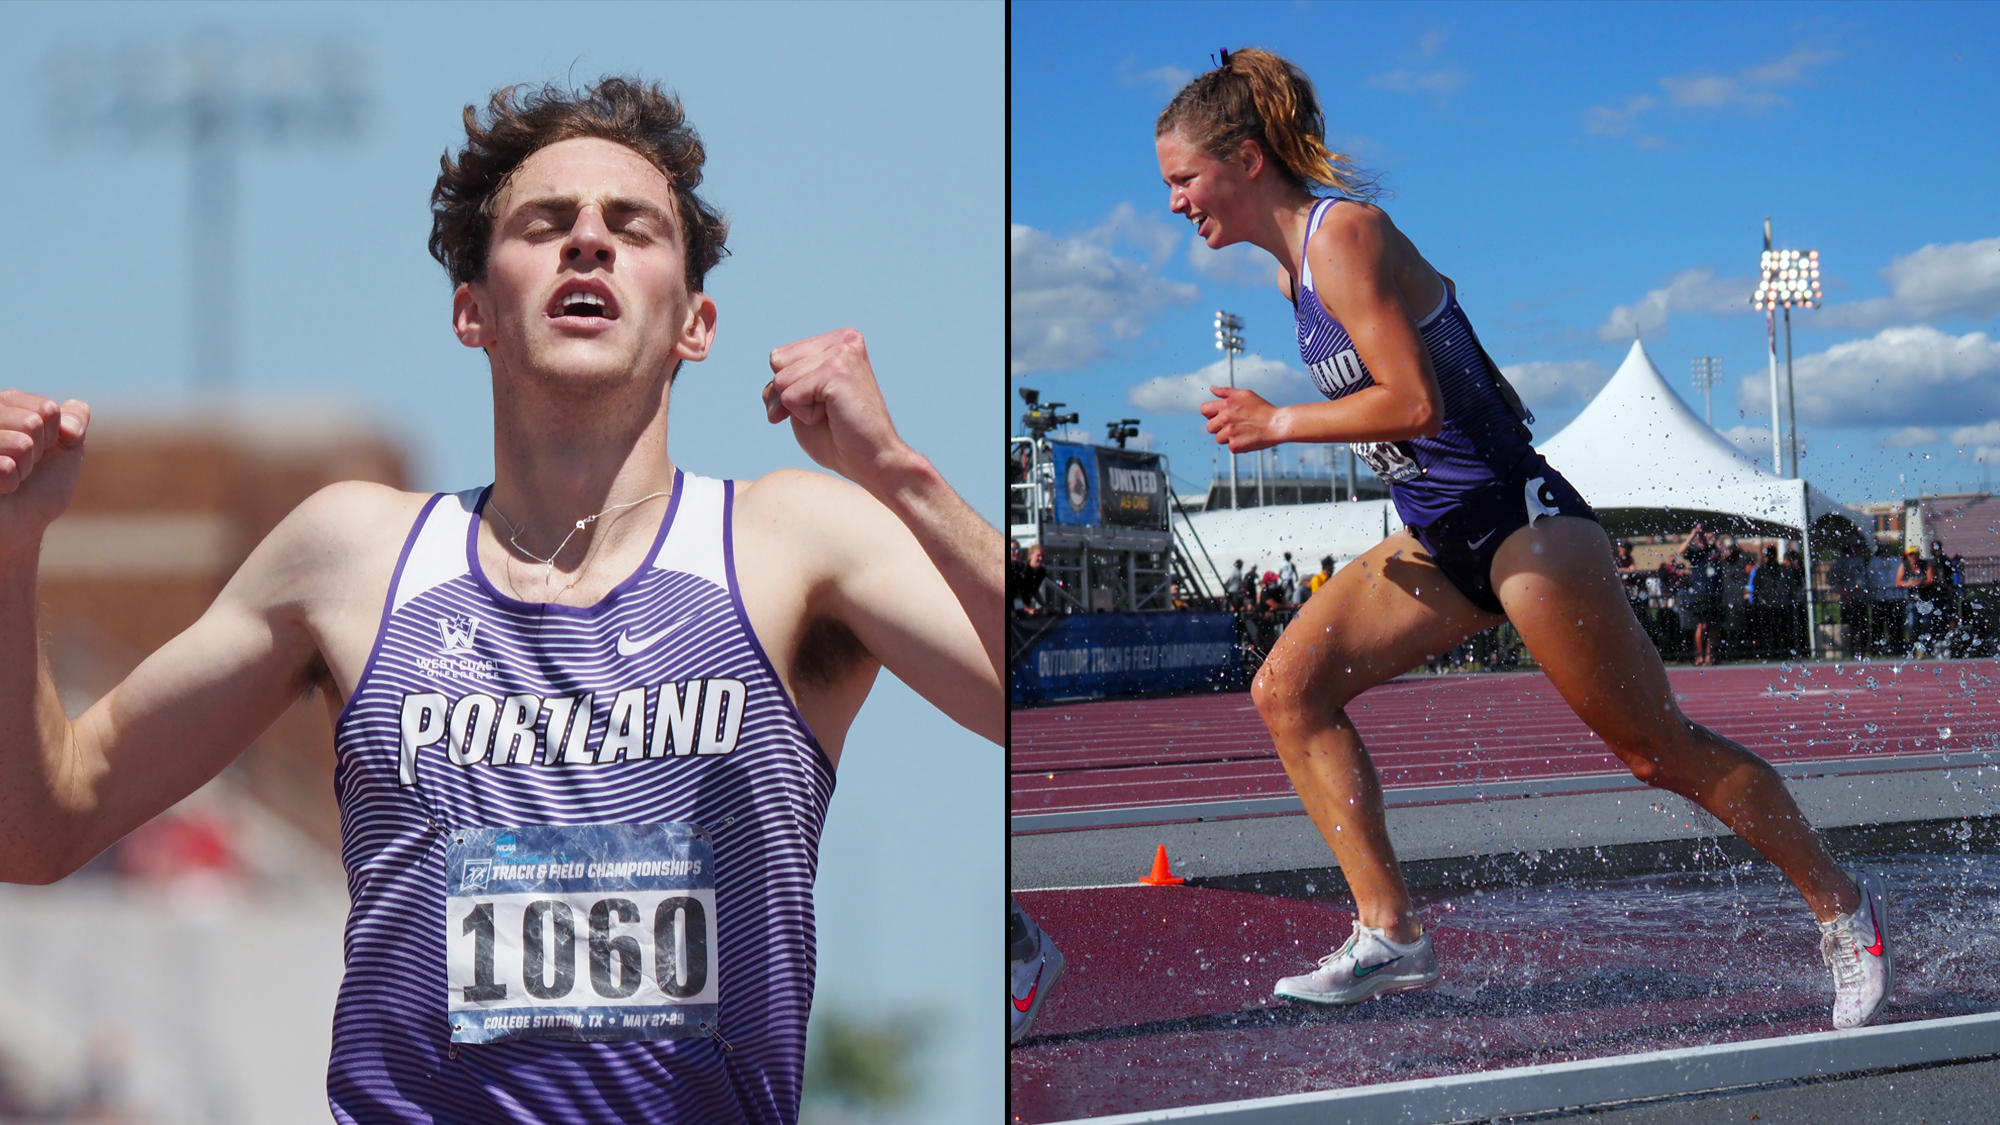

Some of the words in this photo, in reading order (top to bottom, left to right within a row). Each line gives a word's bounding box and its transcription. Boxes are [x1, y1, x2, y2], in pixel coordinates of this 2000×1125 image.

[1306, 348, 1364, 393] AND
[1108, 466, 1158, 494] UNITED
[1121, 494, 1132, 509] AS
[1133, 495, 1149, 510] ONE
[416, 658, 456, 669] WEST
[460, 660, 498, 671] COAST
[1038, 648, 1088, 677] OUTDOOR
[1091, 647, 1122, 673] TRACK
[1133, 645, 1159, 670] FIELD
[418, 669, 499, 680] CONFERENCE
[399, 677, 747, 788] PORTLAND
[496, 844, 516, 852] NCAA
[492, 864, 536, 880] TRACK
[537, 864, 547, 879] &
[549, 862, 585, 879] FIELD
[587, 860, 702, 878] CHAMPIONSHIPS
[462, 896, 708, 1002] 1060
[483, 1015, 530, 1030] COLLEGE
[532, 1014, 584, 1029] STATION,
[588, 1014, 603, 1028] TX
[622, 1013, 649, 1028] MAY
[651, 1012, 685, 1027] 27-29
